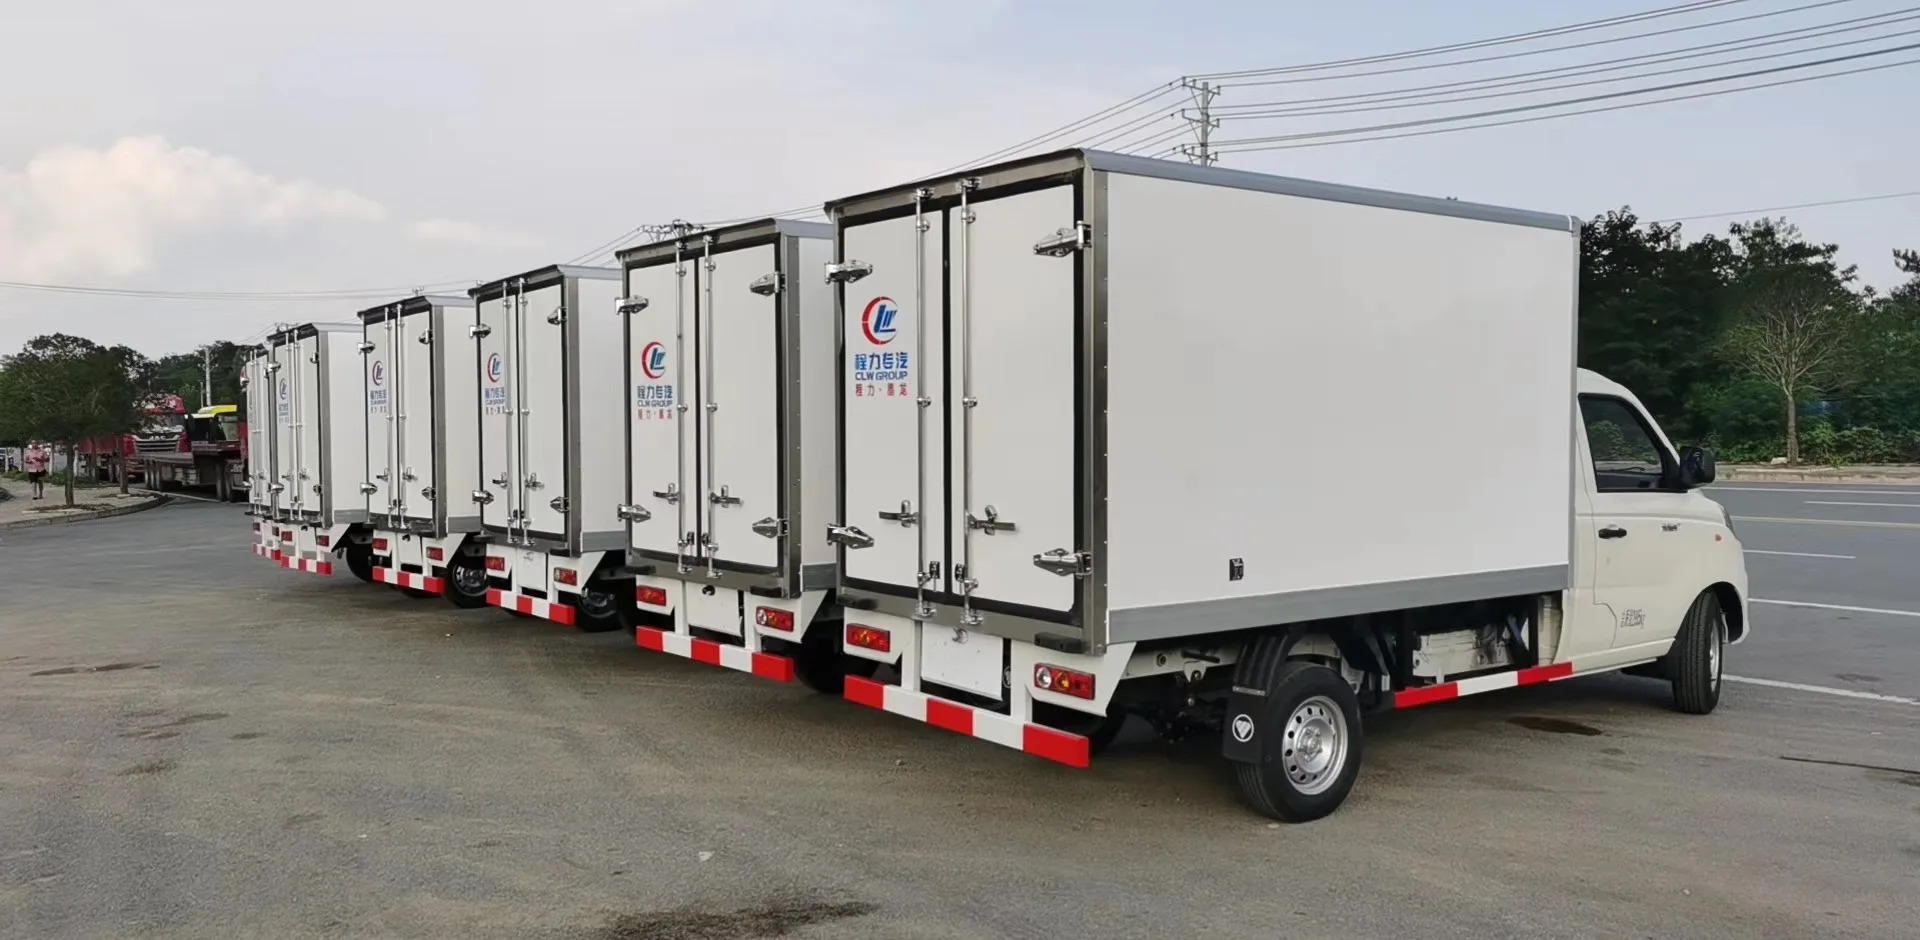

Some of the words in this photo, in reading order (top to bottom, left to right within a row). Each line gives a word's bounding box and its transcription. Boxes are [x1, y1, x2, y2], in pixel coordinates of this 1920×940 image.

[855, 352, 908, 370] 程力专汽
[855, 372, 874, 381] CLW
[876, 371, 908, 381] GROUP
